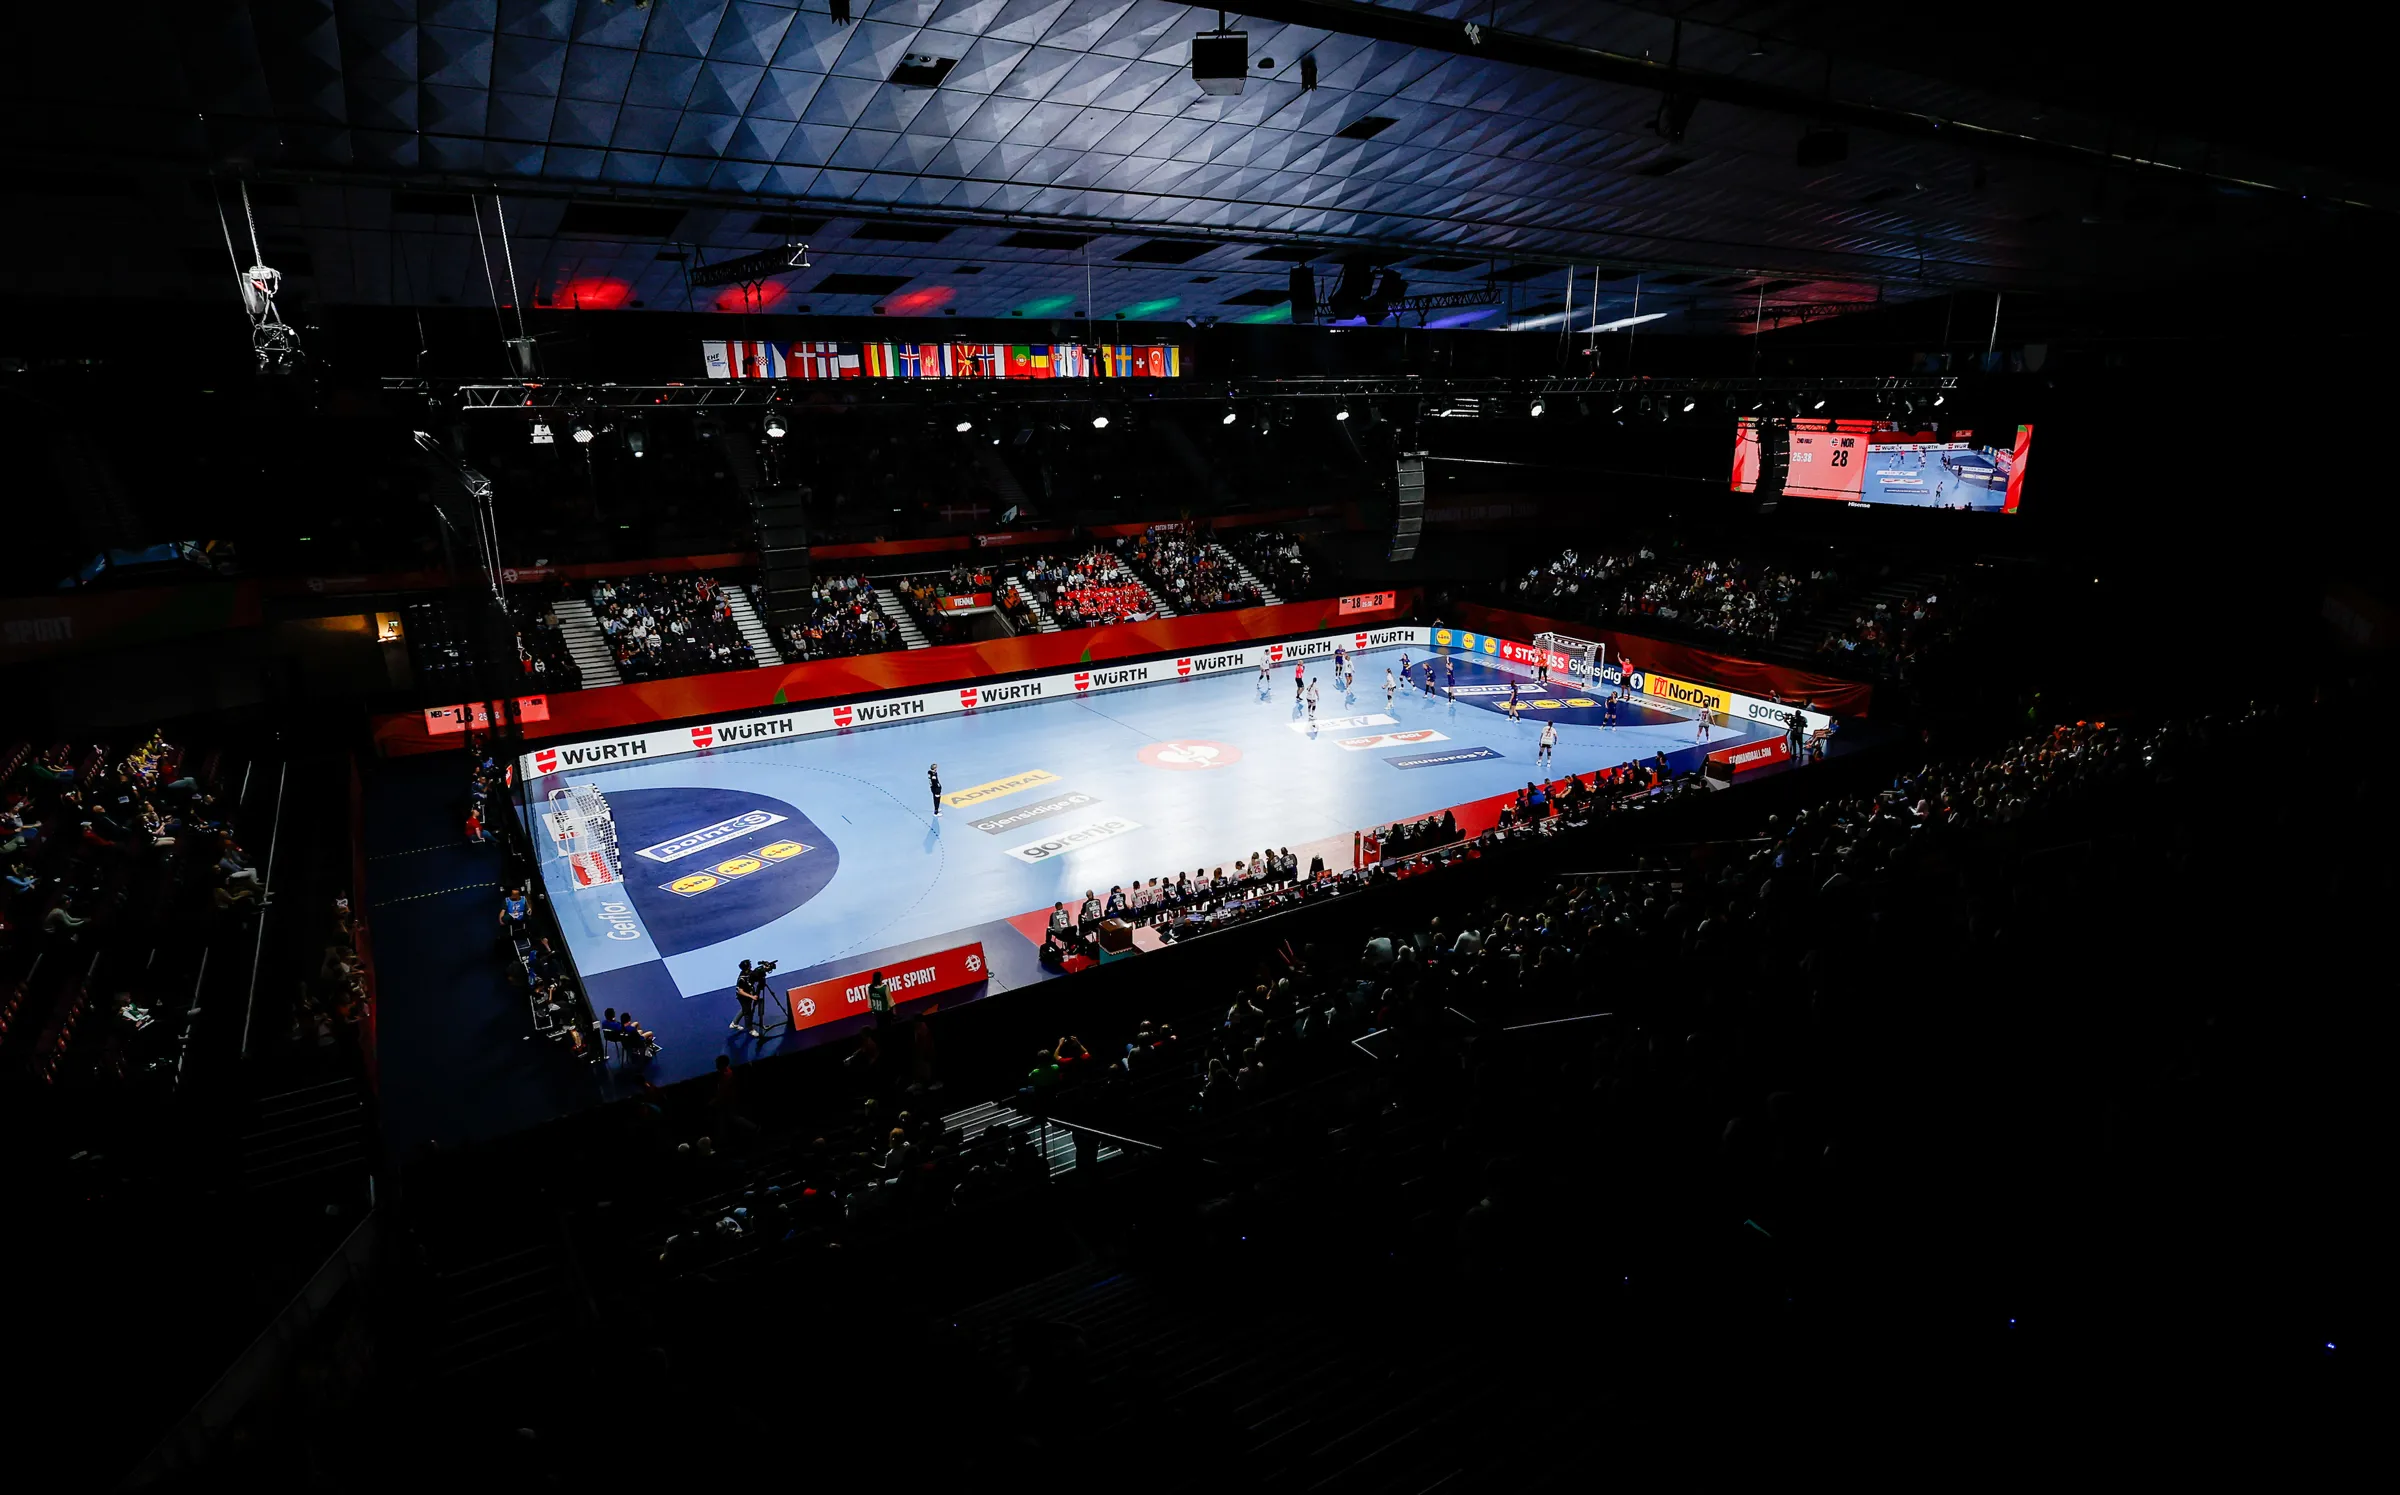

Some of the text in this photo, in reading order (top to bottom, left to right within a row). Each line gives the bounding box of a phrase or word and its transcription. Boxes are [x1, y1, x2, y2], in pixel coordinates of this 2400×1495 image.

[1841, 438, 1855, 448] NOR
[1831, 450, 1849, 467] 28
[1352, 597, 1360, 608] 18
[1374, 594, 1382, 606] 28
[1370, 630, 1414, 645] WÜRTH
[1286, 640, 1331, 658] WÜRTH
[1194, 653, 1244, 672] WÜRTH
[1093, 667, 1148, 686] WÜRTH
[982, 682, 1042, 704] WÜRTH
[1668, 682, 1720, 709] NorDan
[454, 707, 474, 724] 18
[857, 700, 925, 722] WÜRTH
[718, 718, 794, 742] WÜRTH
[562, 739, 647, 766] WÜRTH
[1398, 754, 1478, 766] GRUNDFOS
[950, 772, 1054, 805] ADMIRAL
[976, 800, 1071, 832] Gjensidige
[661, 824, 734, 854] point
[1022, 818, 1127, 859] gorenje
[598, 901, 640, 941] Gerflor
[882, 976, 903, 993] THE
[904, 966, 937, 989] SPIRIT
